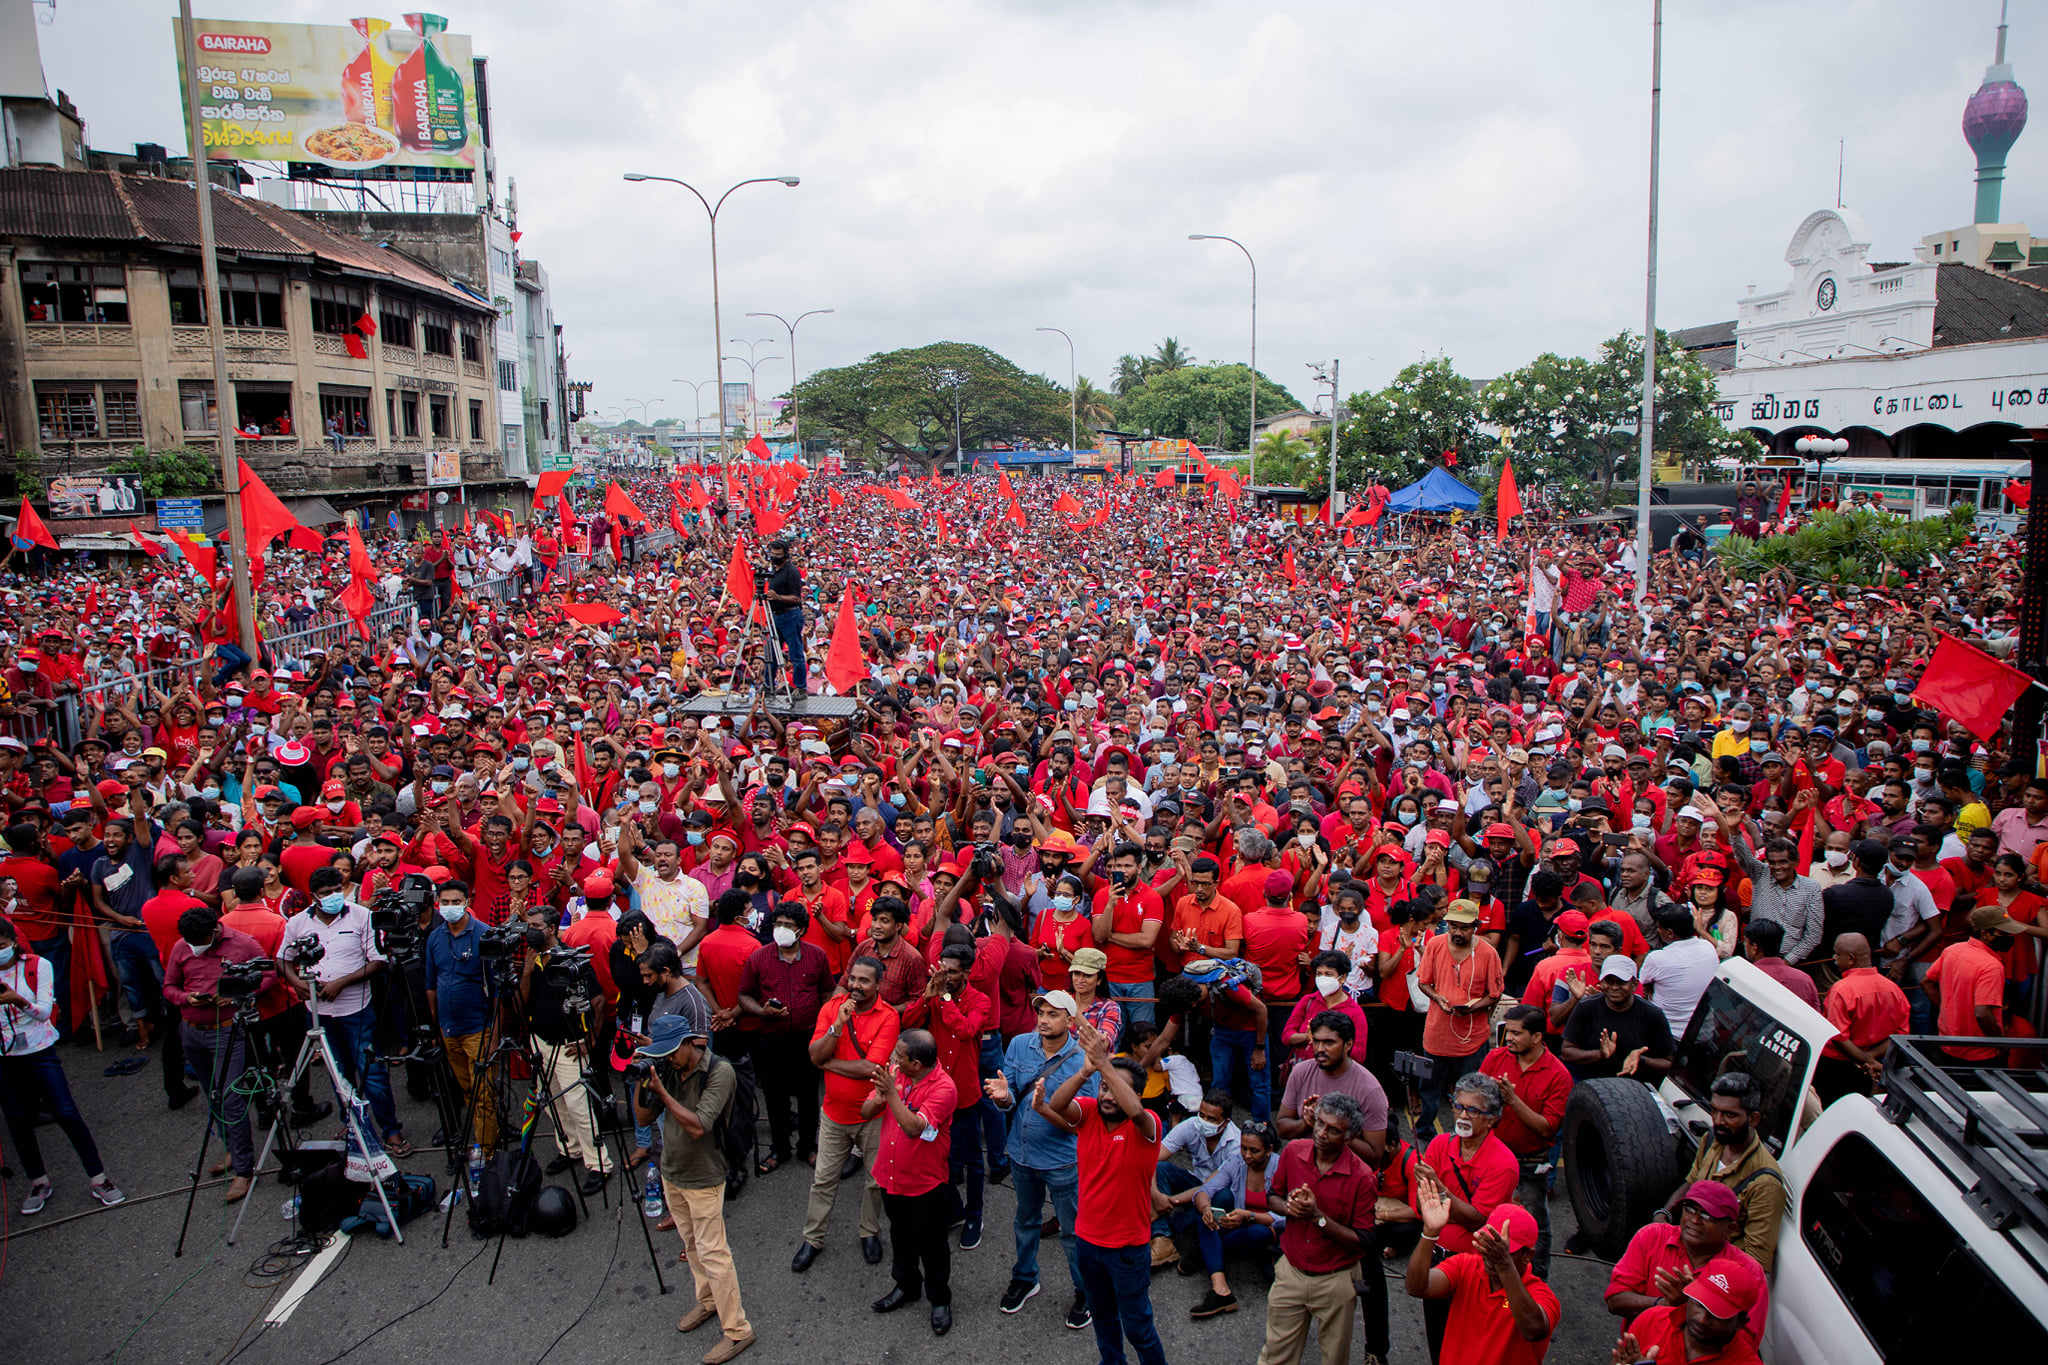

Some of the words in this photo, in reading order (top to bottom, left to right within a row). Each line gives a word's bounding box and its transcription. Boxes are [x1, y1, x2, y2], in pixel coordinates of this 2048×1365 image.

[203, 36, 268, 52] BAIRAHA
[196, 66, 238, 85] වුරුදු
[211, 85, 240, 100] වඩා
[360, 71, 377, 127] BAIRAHA
[413, 79, 431, 140] BAIRAHA
[1873, 393, 1964, 415] கோட்டை
[1759, 1036, 1793, 1062] LANKA
[1773, 1030, 1800, 1053] 4X4
[346, 1160, 370, 1173] FASHIO
[373, 1160, 388, 1170] UG
